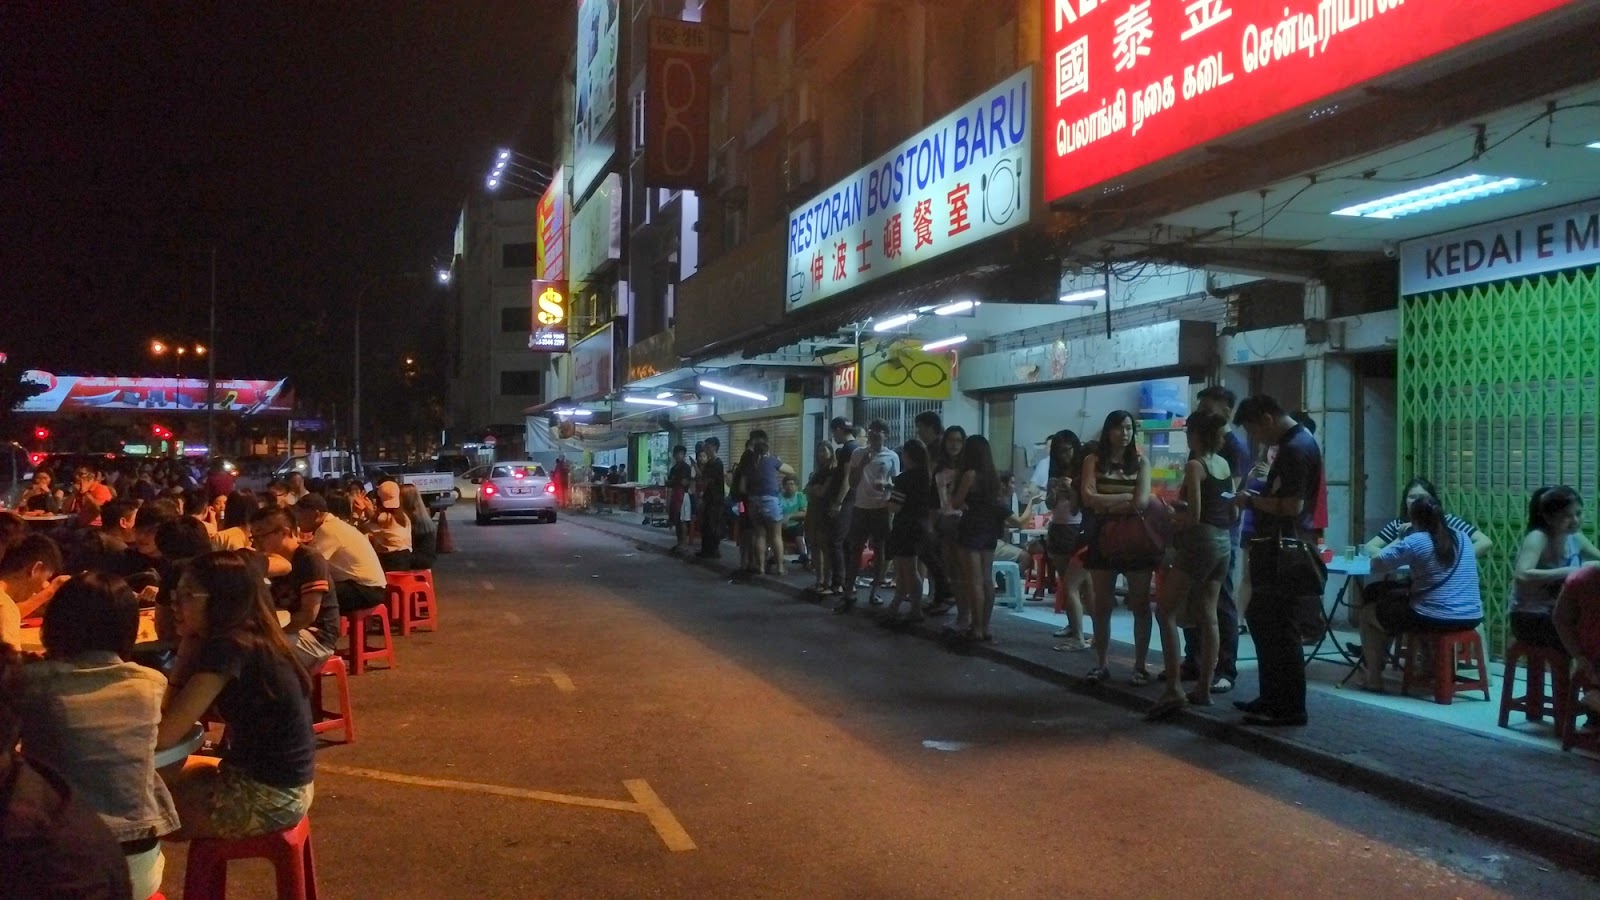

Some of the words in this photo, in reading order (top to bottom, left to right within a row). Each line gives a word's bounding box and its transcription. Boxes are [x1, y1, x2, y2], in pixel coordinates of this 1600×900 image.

[790, 179, 863, 257] RESTORAN
[867, 128, 948, 217] BOSTON
[954, 81, 1027, 173] BARU
[1425, 229, 1522, 280] KEDAI
[1537, 223, 1554, 259] E
